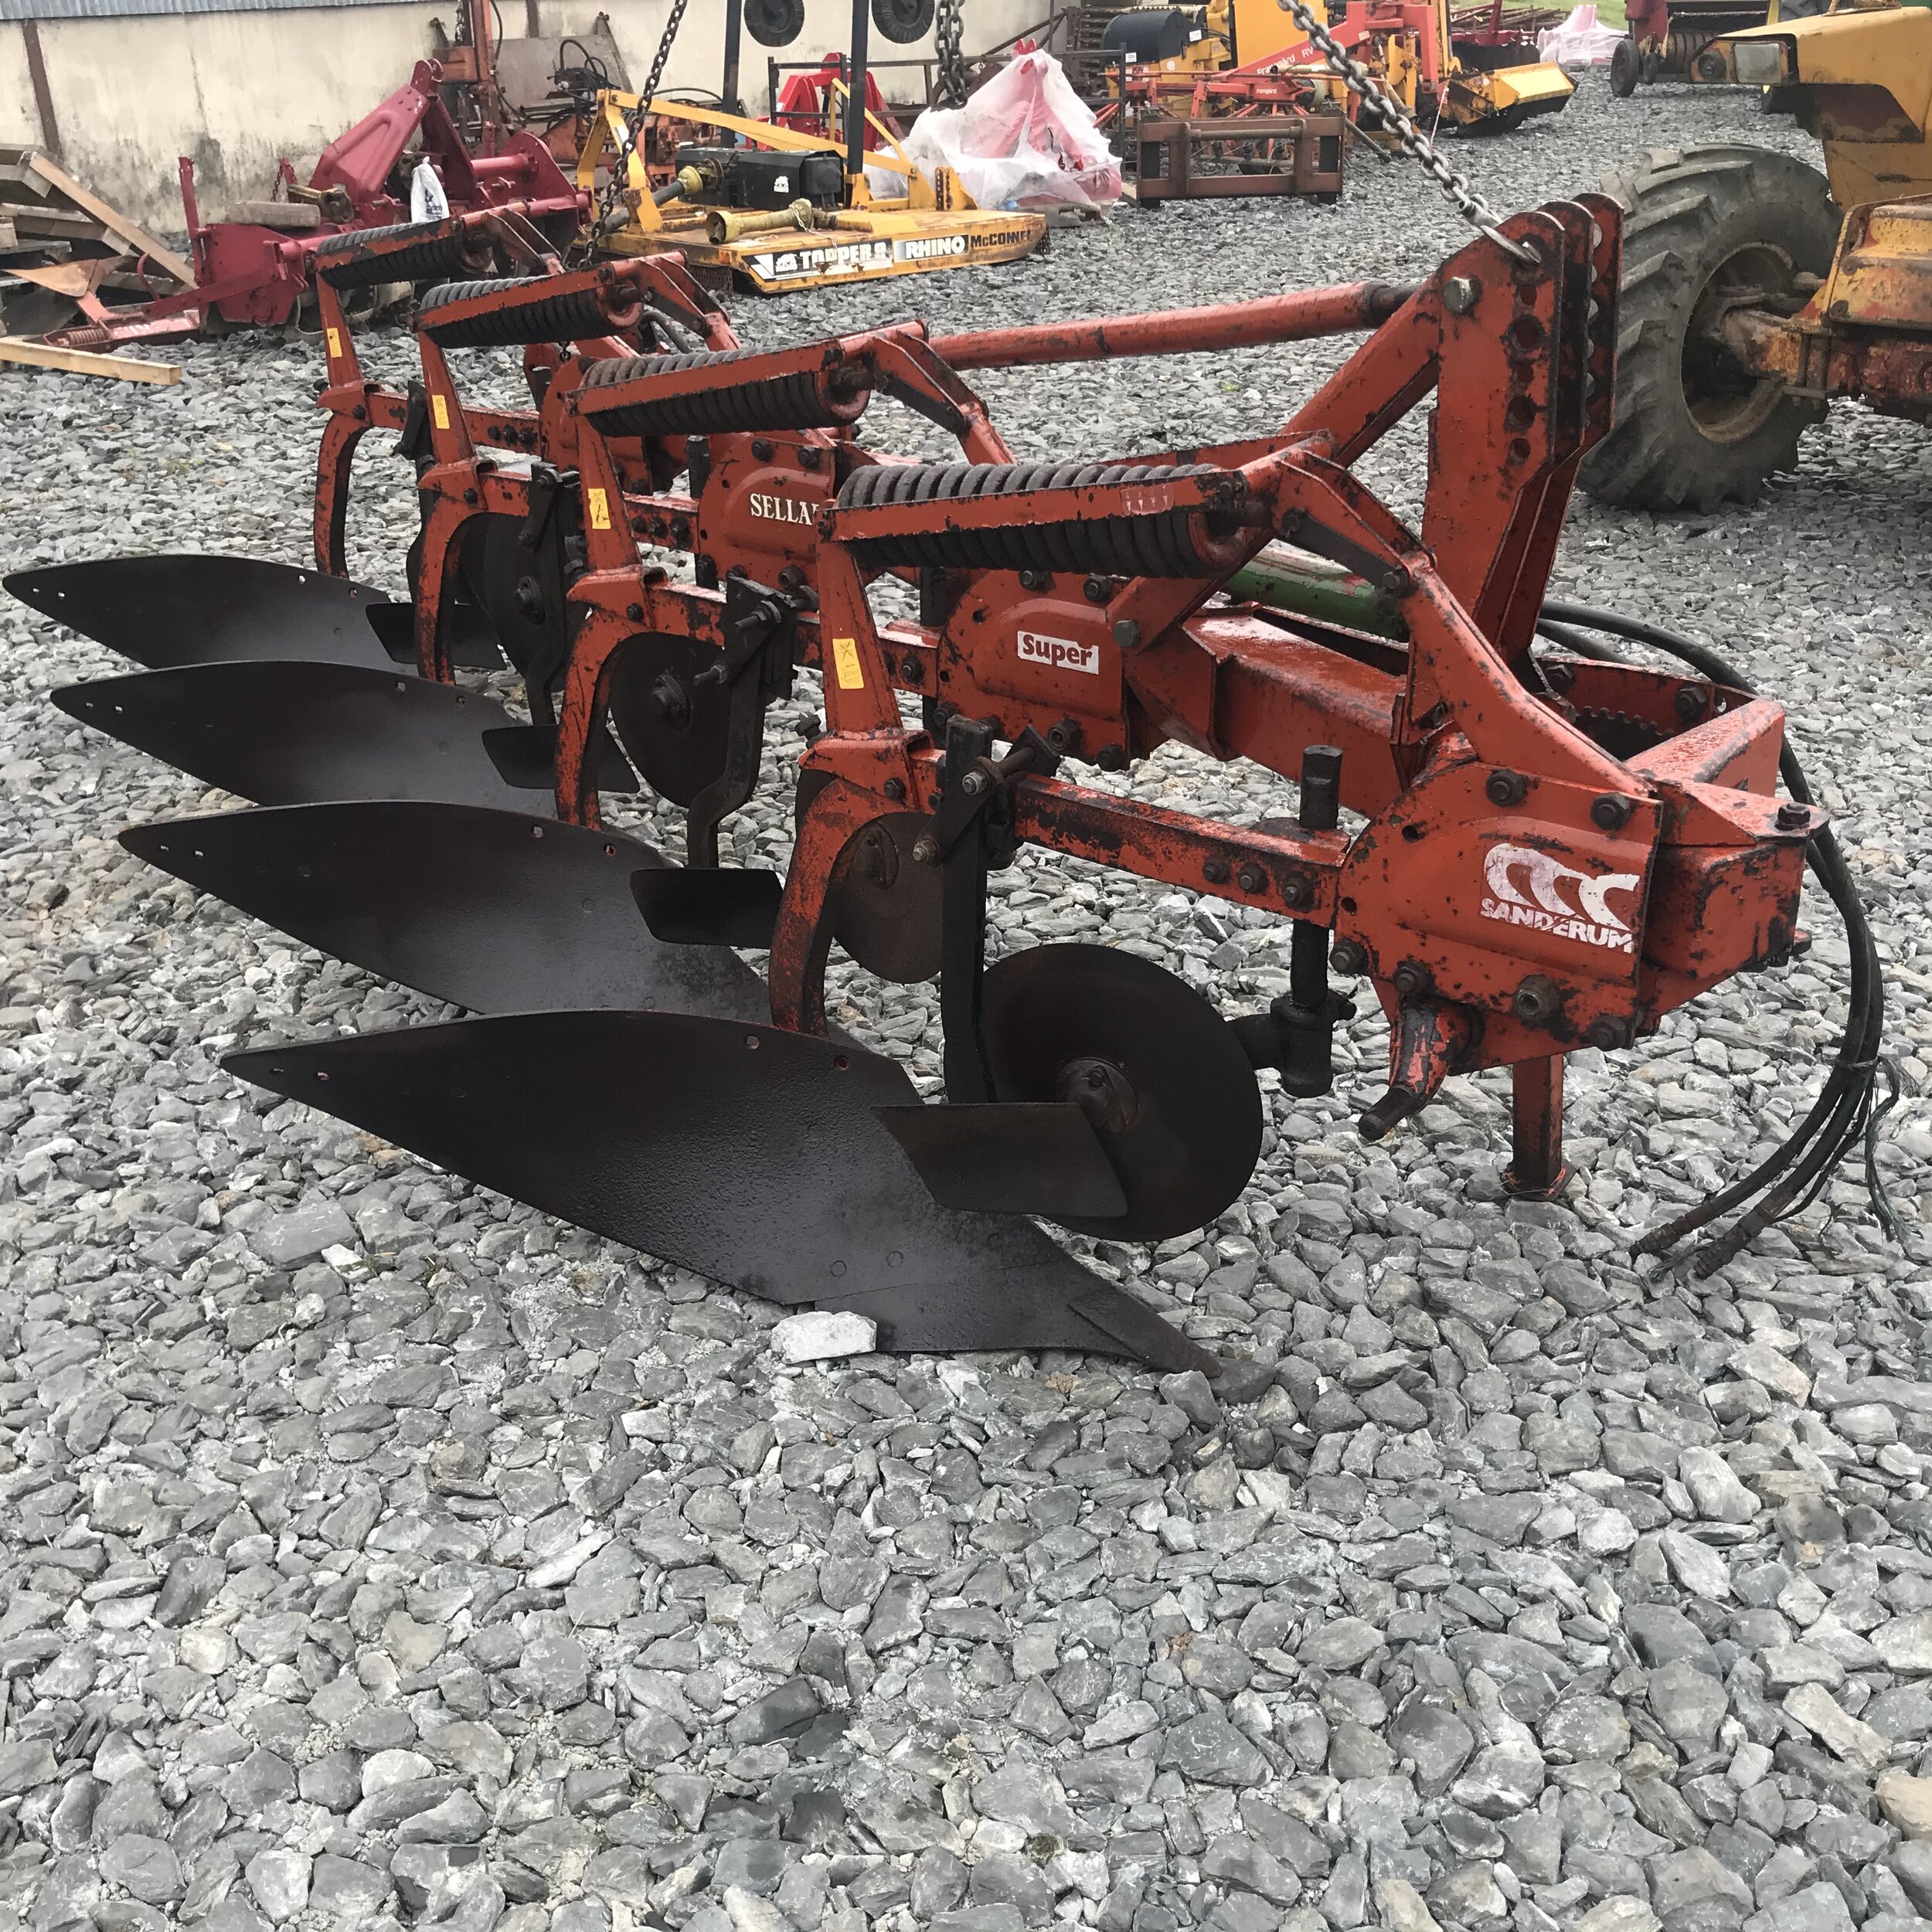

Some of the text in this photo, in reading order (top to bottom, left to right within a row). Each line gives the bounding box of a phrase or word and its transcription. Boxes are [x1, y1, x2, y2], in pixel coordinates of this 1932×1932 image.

[905, 235, 966, 260] RHINO
[1022, 634, 1093, 667] Super
[1480, 897, 1634, 954] SANDERUM
